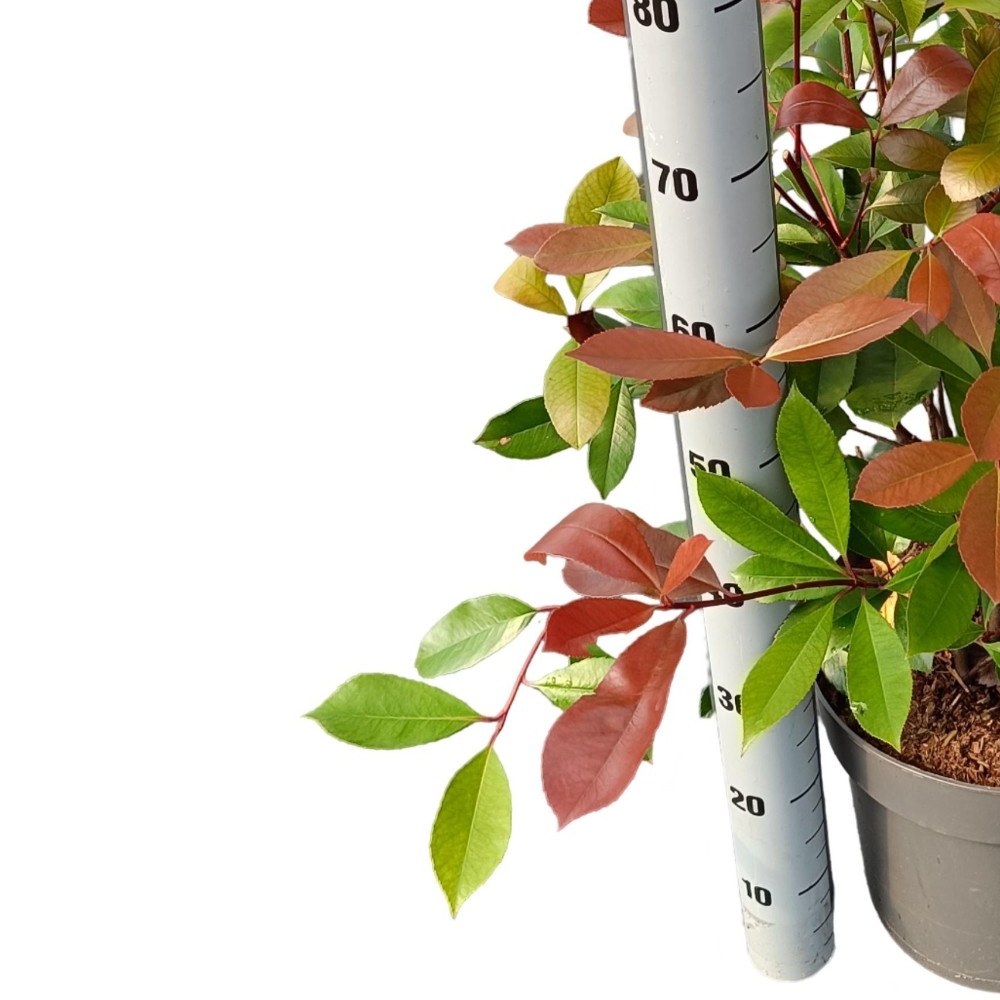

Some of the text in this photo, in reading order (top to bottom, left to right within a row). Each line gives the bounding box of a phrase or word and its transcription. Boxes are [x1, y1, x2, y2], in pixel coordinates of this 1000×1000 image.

[652, 158, 698, 202] 70
[730, 786, 765, 816] 20
[742, 878, 772, 907] 10
